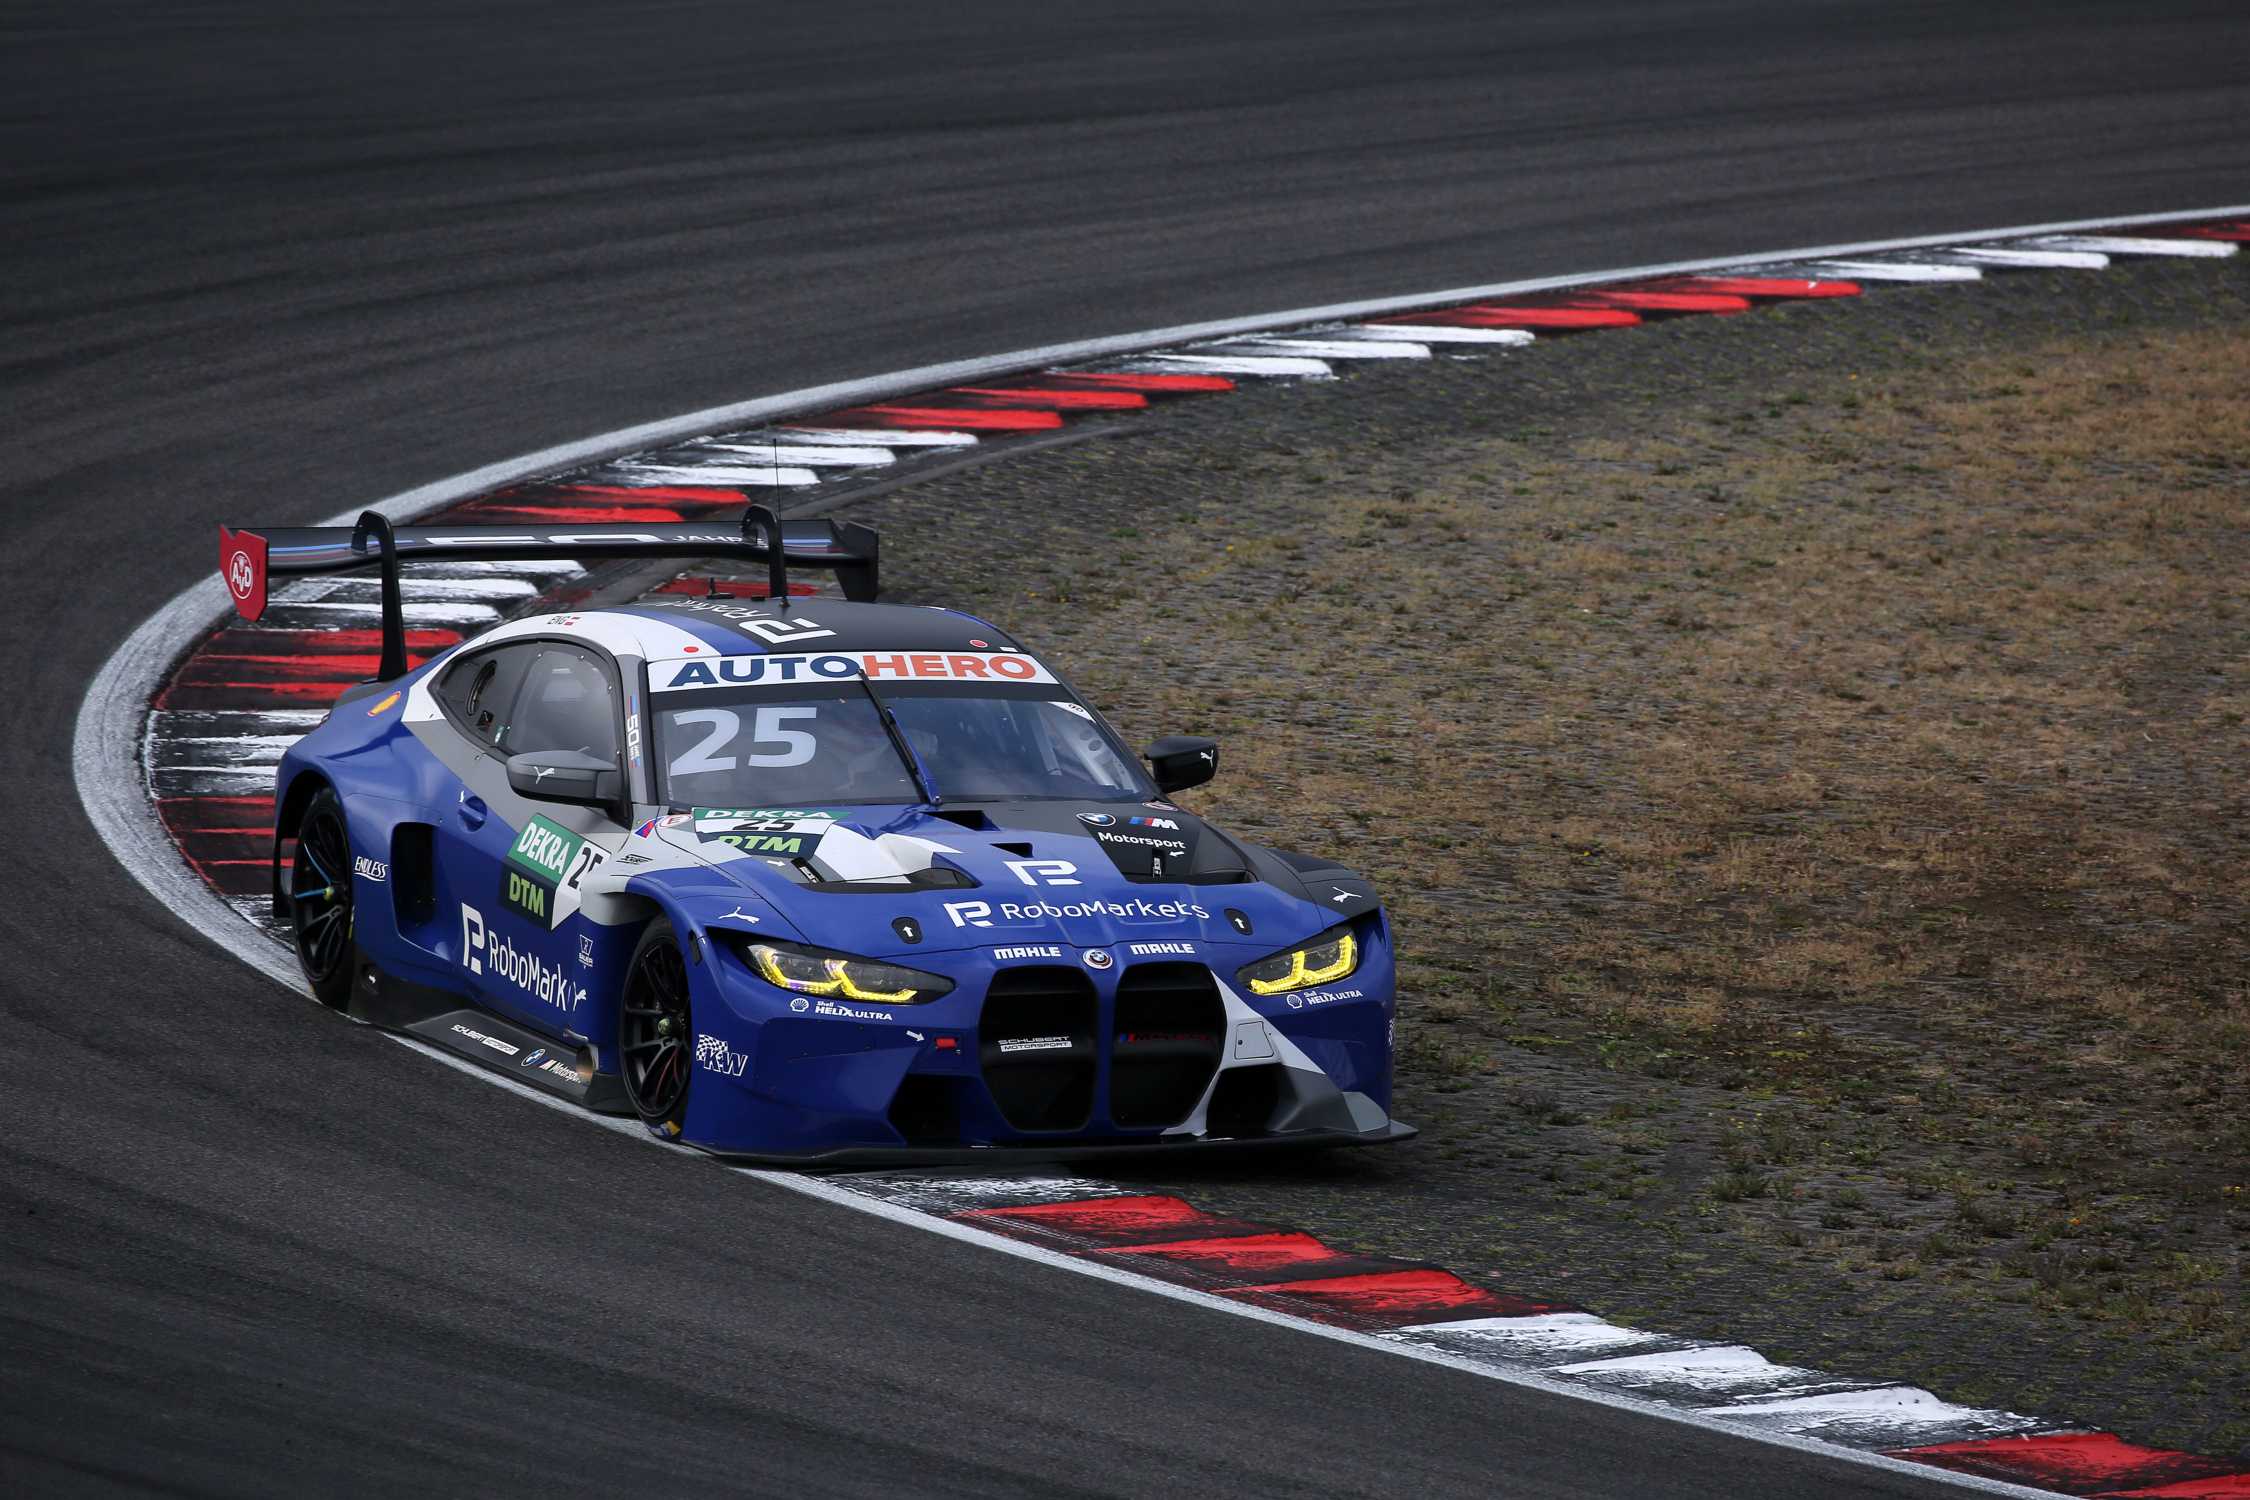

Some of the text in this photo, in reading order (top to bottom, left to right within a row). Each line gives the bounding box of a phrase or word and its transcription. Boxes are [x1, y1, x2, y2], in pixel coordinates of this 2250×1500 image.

[667, 654, 1036, 688] AUTOHERO
[670, 707, 817, 776] 25
[704, 809, 832, 819] DEKRA
[732, 819, 795, 832] 25
[517, 822, 570, 875] DEKRA
[718, 835, 802, 853] DTM
[1098, 832, 1186, 849] Motorsport
[354, 855, 388, 879] ENDLESS
[509, 872, 544, 918] DTM
[1000, 898, 1210, 919] RoboMarkets
[993, 946, 1061, 960] MAHLE
[1130, 943, 1196, 955] MAHLE
[488, 929, 571, 1012] RoboMark
[1306, 989, 1363, 1005] HELIX ULTRA
[815, 1006, 893, 1021] HELIX ULTRA
[997, 1036, 1069, 1045] SCHUBERT
[1003, 1040, 1070, 1051] MOTORSPORT
[703, 1047, 749, 1077] KW
